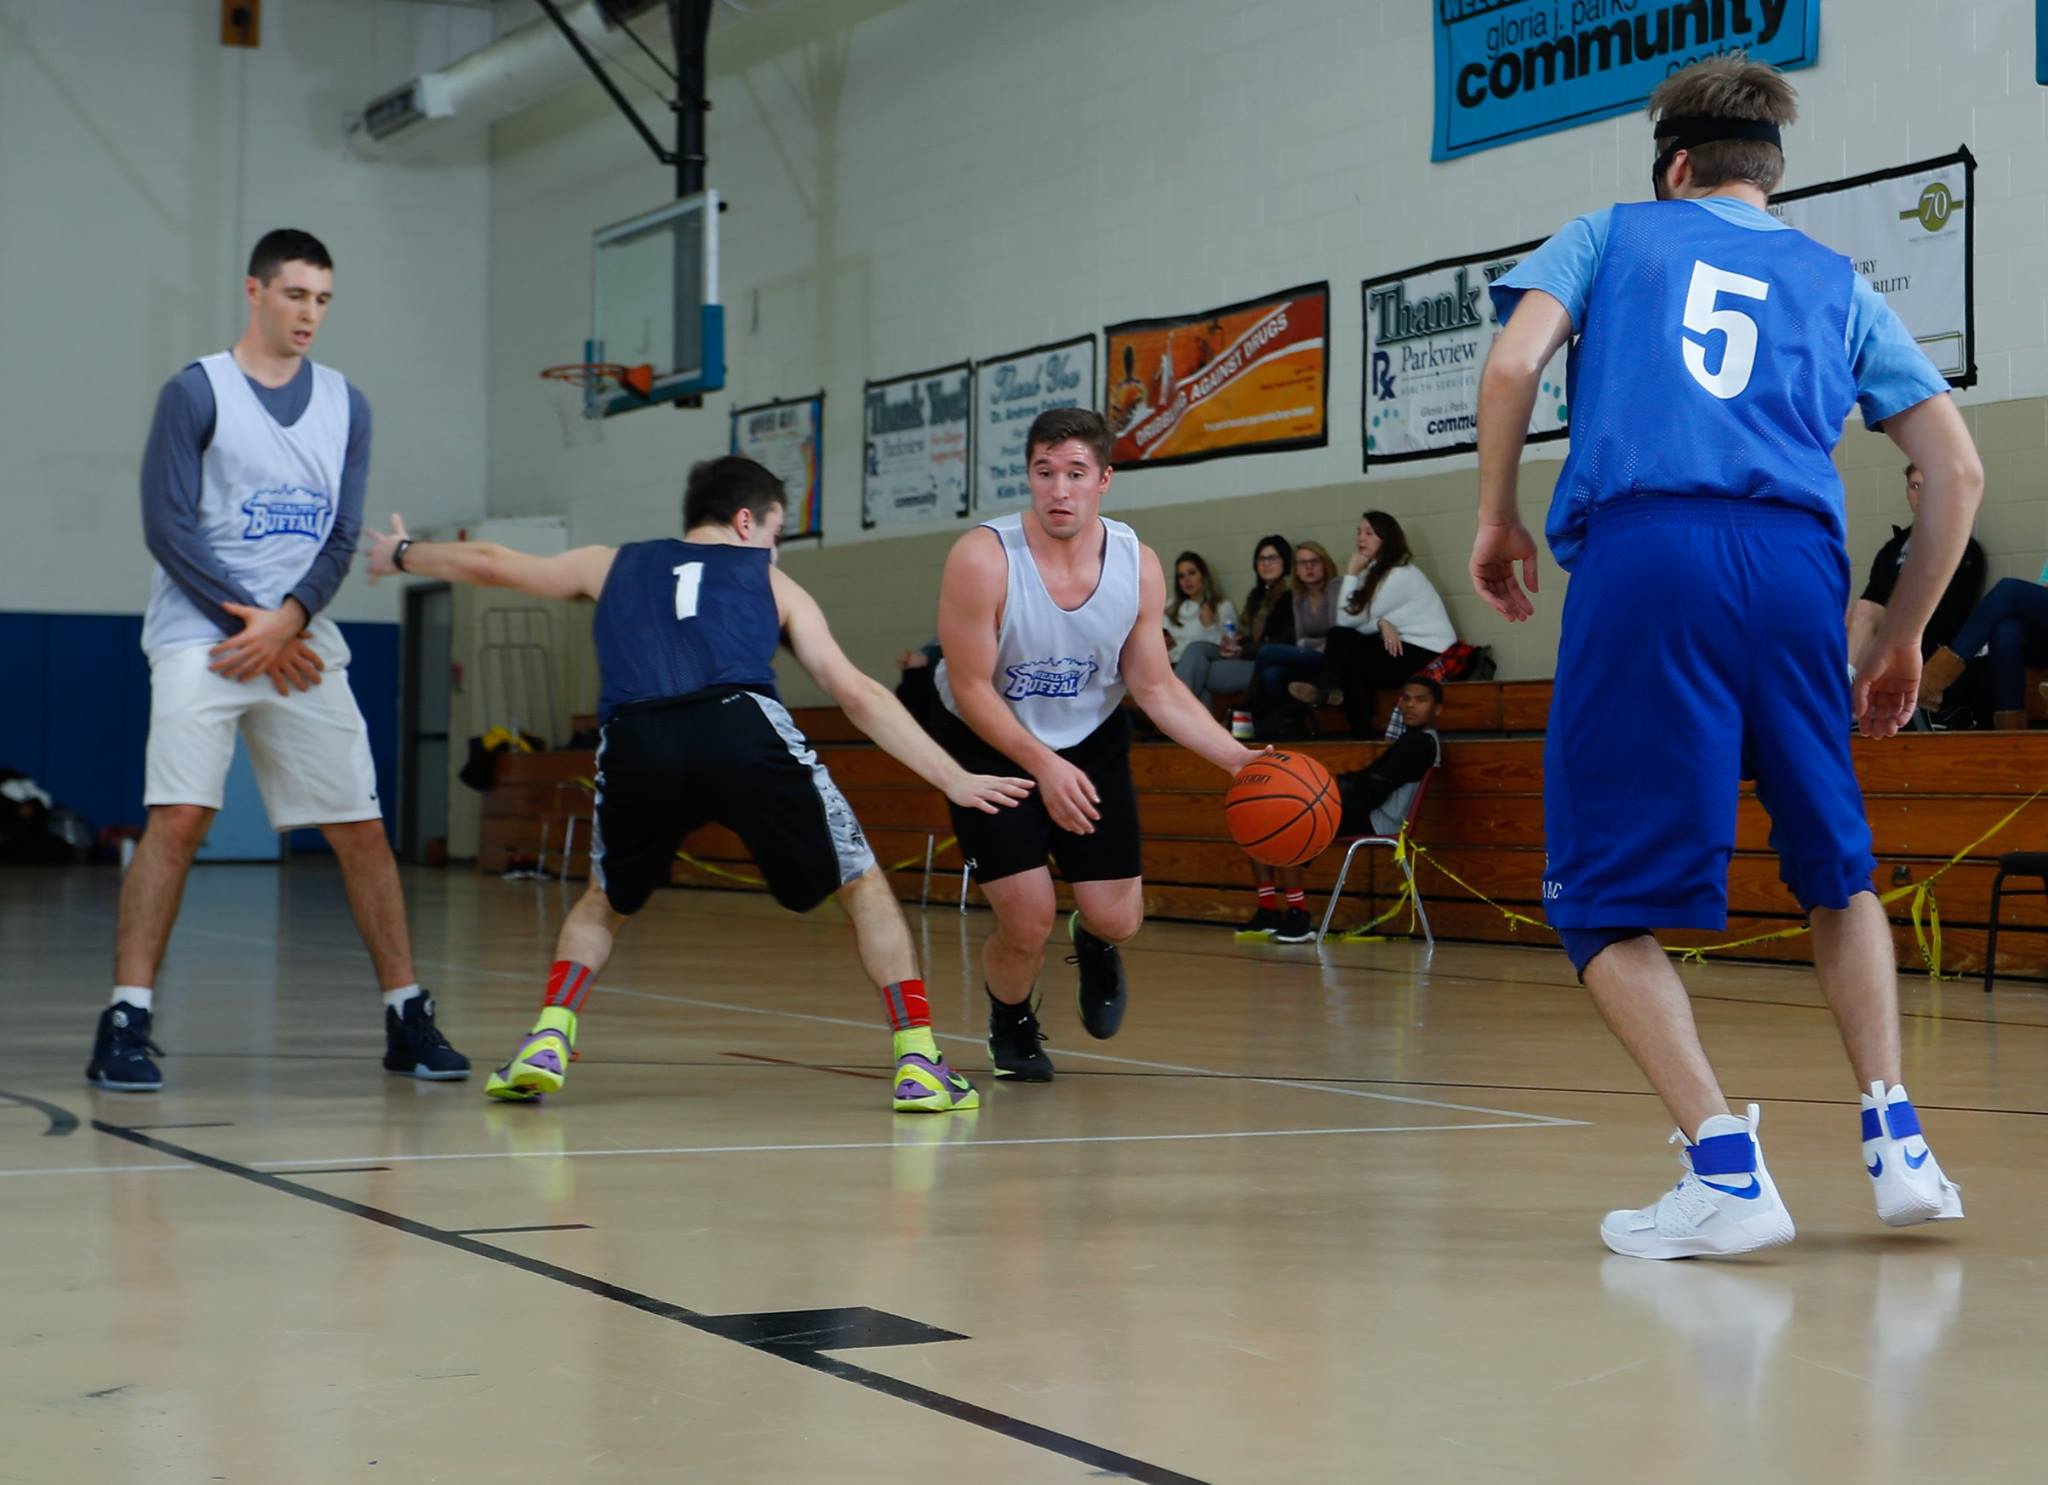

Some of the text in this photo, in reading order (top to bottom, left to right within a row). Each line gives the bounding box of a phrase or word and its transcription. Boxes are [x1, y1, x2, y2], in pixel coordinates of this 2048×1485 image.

[1456, 0, 1788, 109] community
[1486, 7, 1547, 60] gloria
[1922, 190, 1948, 222] 70
[1853, 259, 1878, 275] URY
[1872, 275, 1911, 294] BILITY
[1369, 265, 1481, 347] Thank
[1681, 259, 1770, 400] 5
[1191, 348, 1243, 402] AGAINST
[1243, 313, 1288, 359] DRUGS
[1400, 338, 1479, 374] Parkview
[1426, 414, 1477, 435] commu
[672, 561, 704, 621] 1
